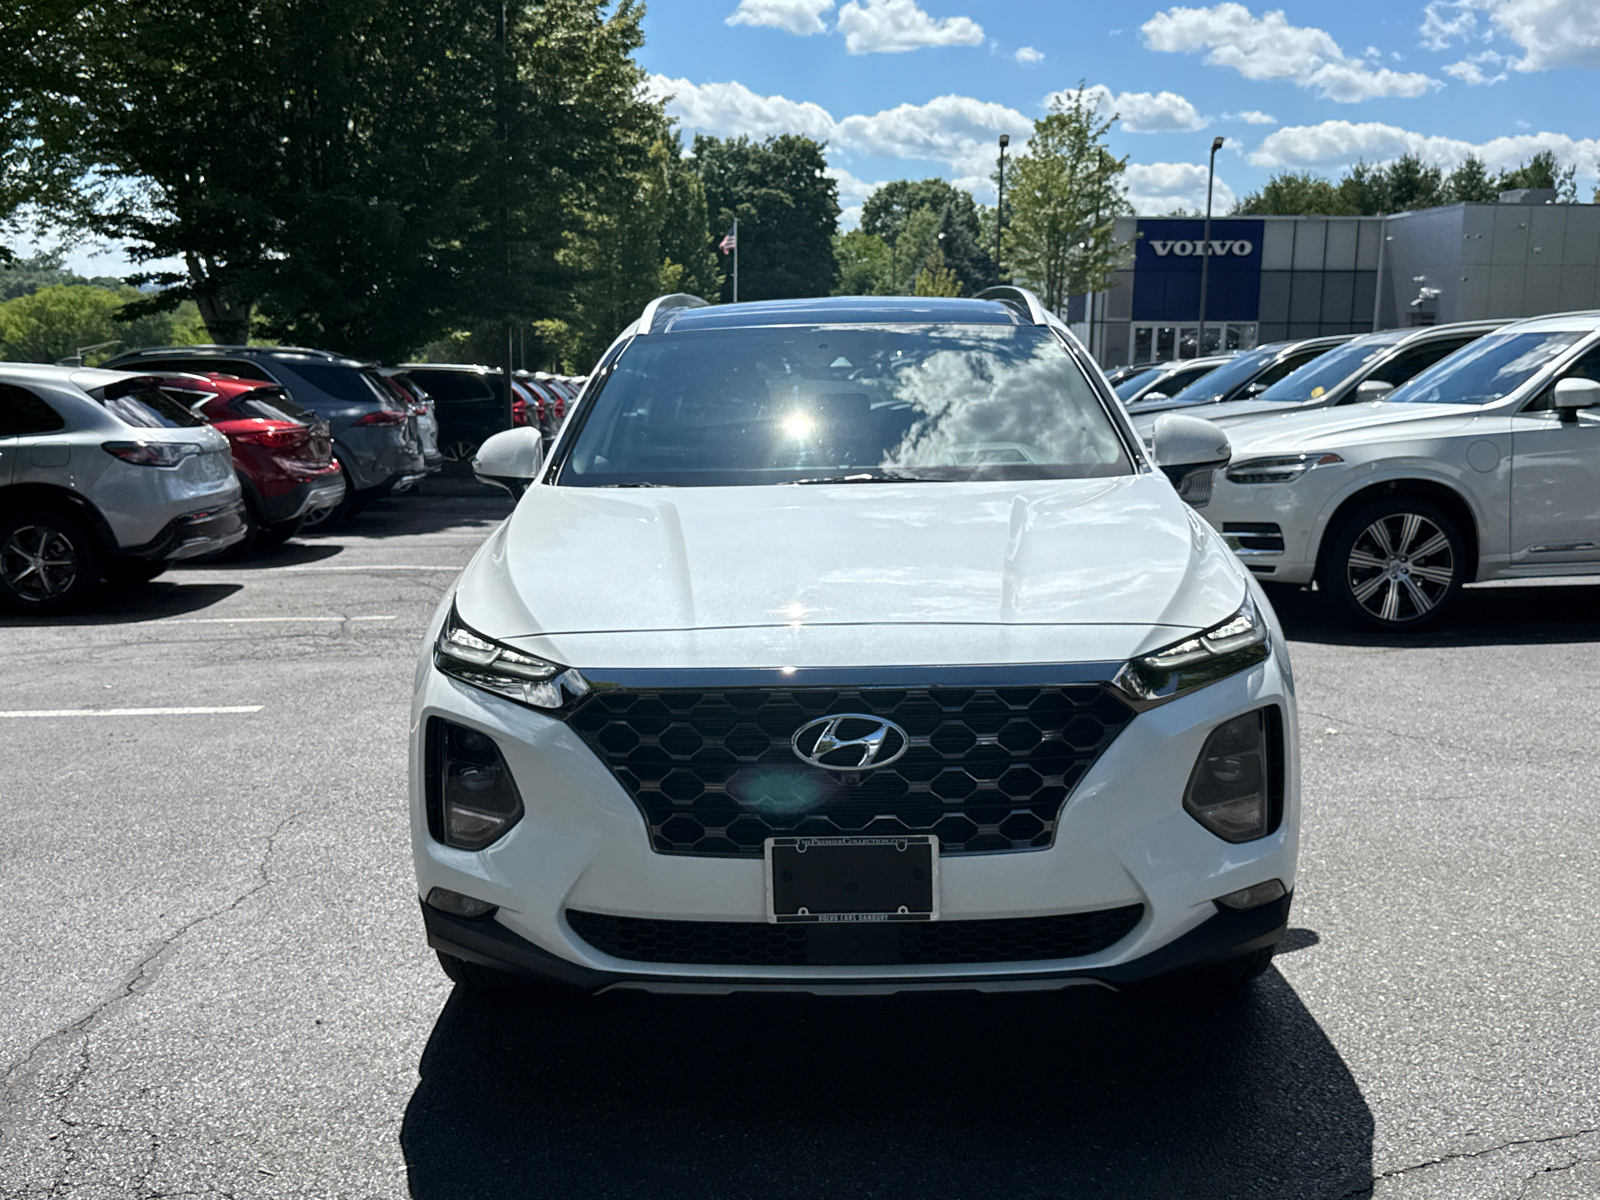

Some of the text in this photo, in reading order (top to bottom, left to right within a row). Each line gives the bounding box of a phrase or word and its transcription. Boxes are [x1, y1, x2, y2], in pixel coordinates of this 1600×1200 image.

[1149, 240, 1253, 257] VOLVO
[818, 914, 838, 922] VOLVO
[840, 914, 856, 922] CARS
